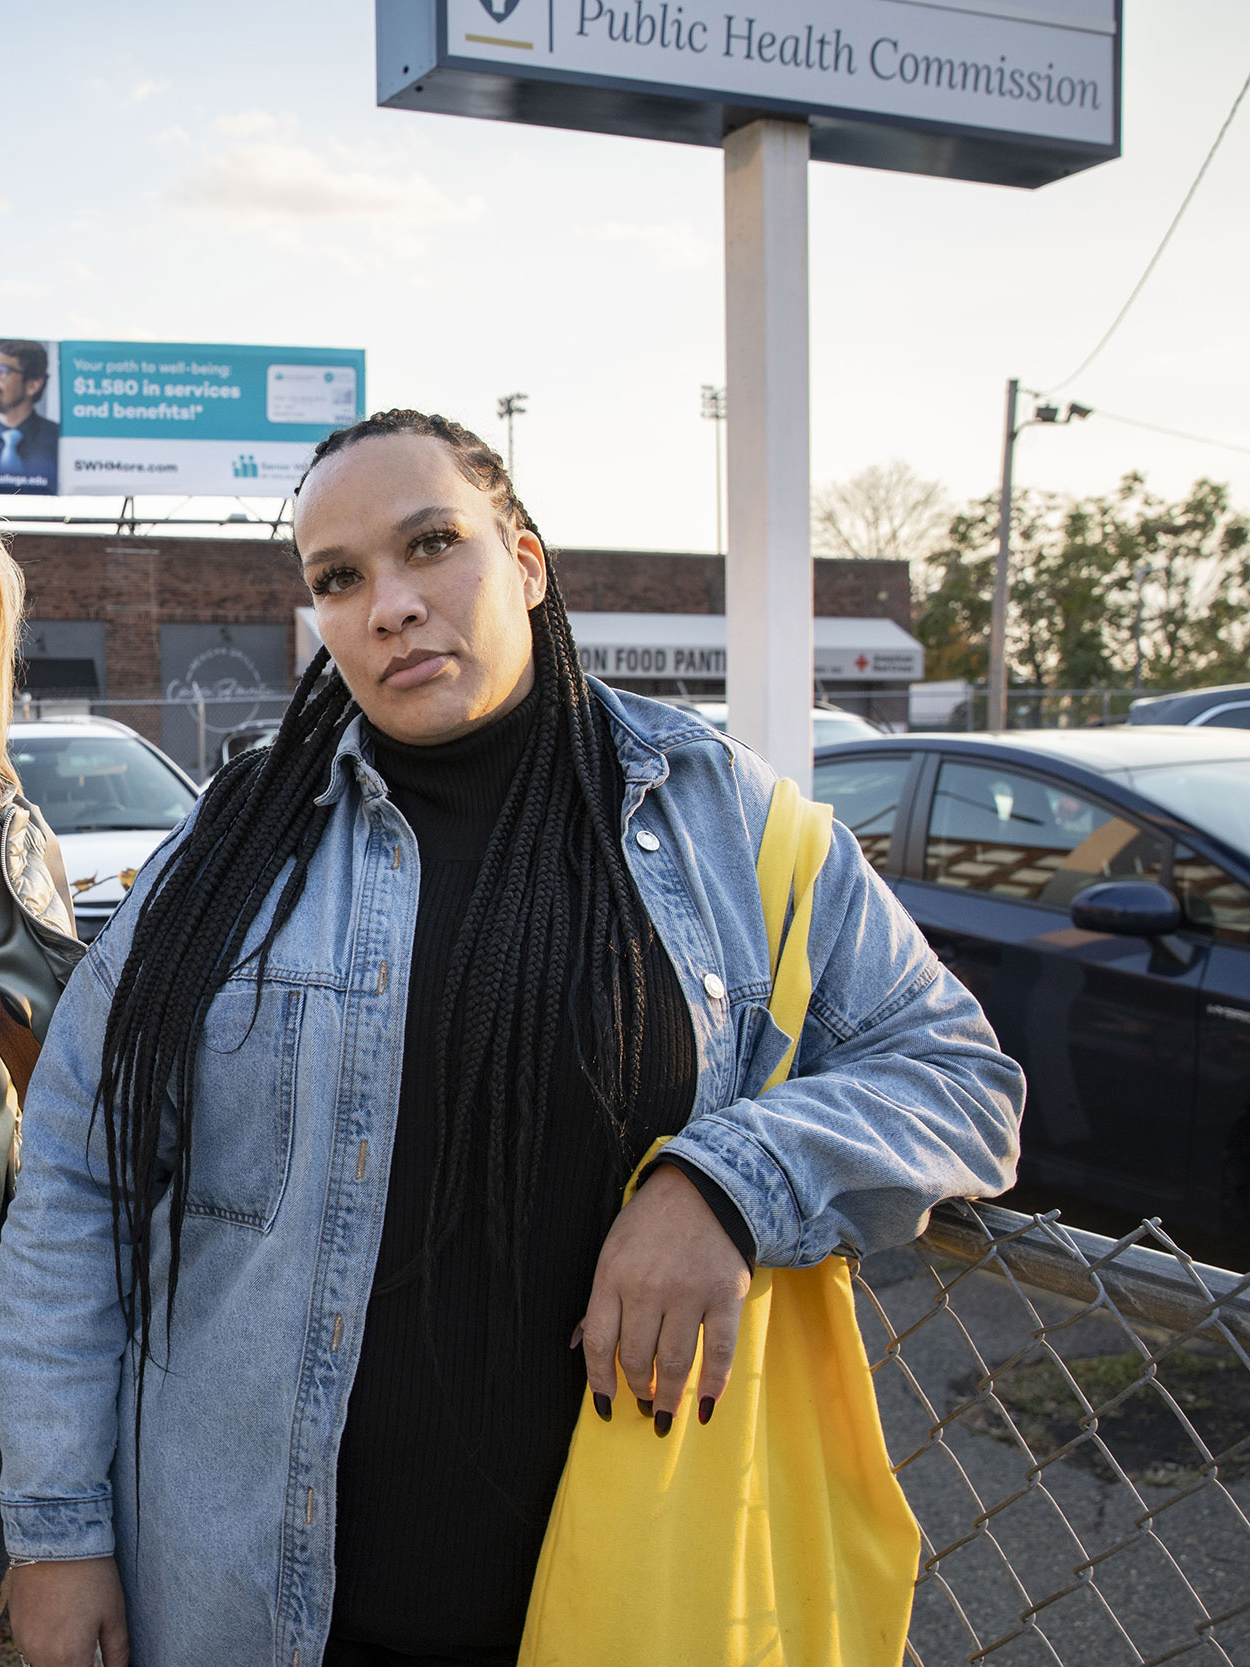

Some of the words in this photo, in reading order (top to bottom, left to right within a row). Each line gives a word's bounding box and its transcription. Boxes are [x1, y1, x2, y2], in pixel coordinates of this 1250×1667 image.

[576, 0, 708, 53] Public
[722, 14, 857, 76] Health
[869, 37, 1101, 110] Commission
[73, 358, 103, 371] Your
[105, 359, 139, 374] path
[141, 361, 156, 373] to
[73, 376, 139, 396] $1,580
[142, 379, 160, 396] in
[164, 381, 241, 399] services
[73, 401, 109, 418] and
[74, 459, 178, 473] SWHMore.com
[615, 648, 667, 672] FOOD
[674, 648, 727, 673] PANT
